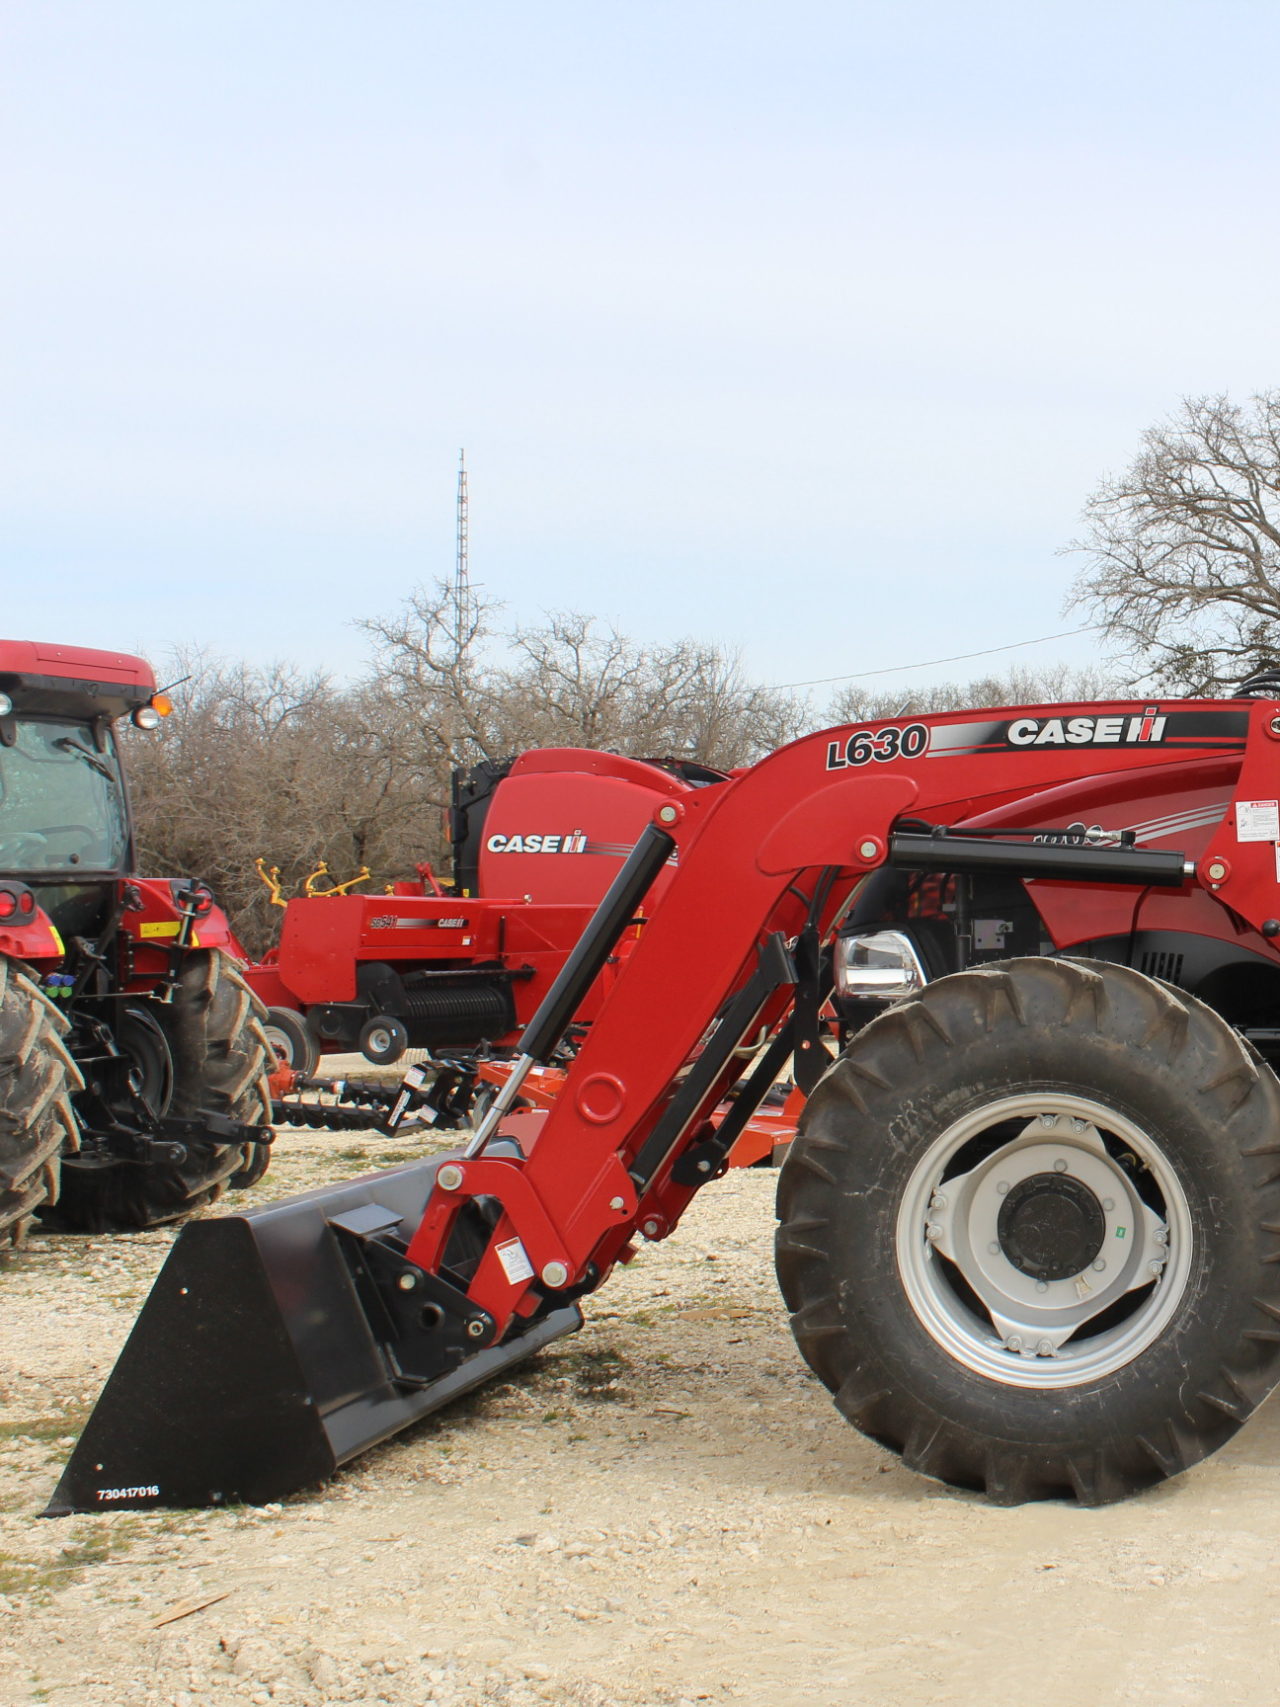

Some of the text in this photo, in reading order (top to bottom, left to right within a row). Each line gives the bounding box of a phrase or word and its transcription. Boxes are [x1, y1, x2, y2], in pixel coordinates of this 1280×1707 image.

[1006, 716, 1126, 747] CASE
[826, 723, 929, 771] L630
[487, 834, 561, 853] CASE
[96, 1484, 160, 1501] 730417016
